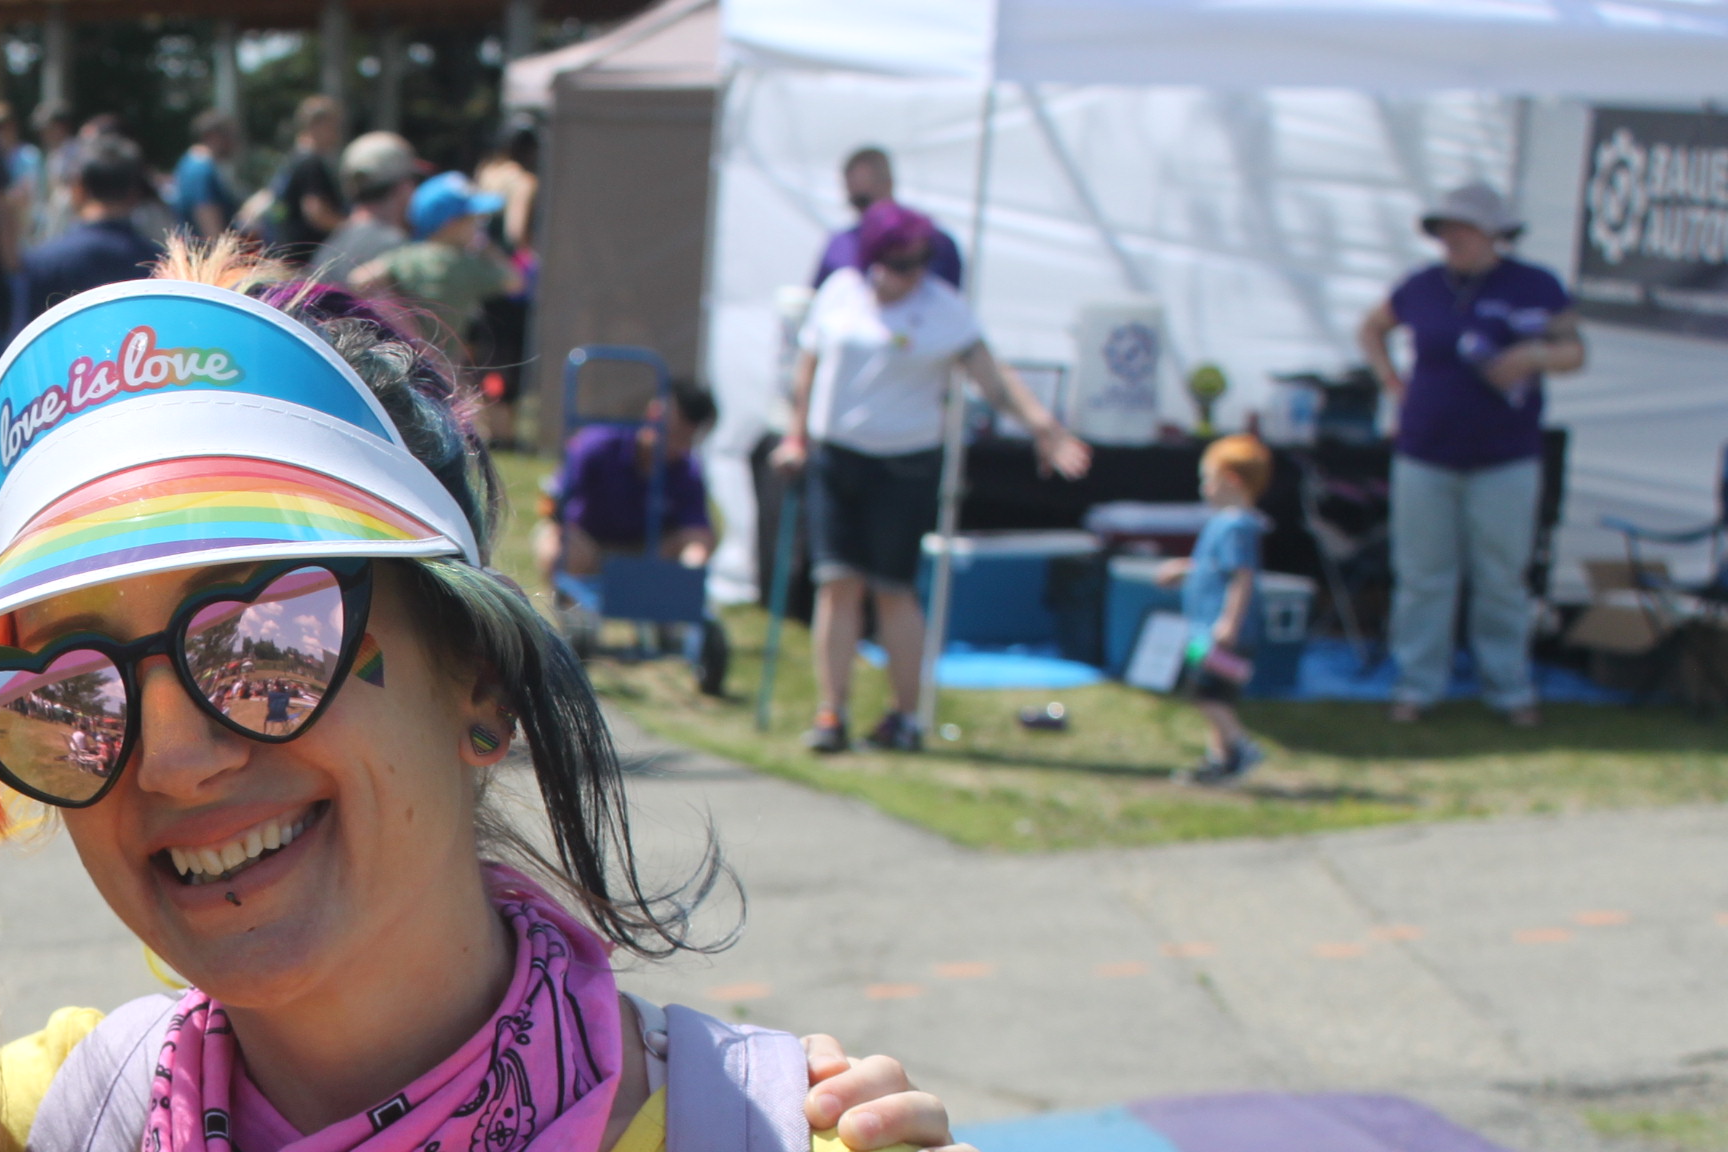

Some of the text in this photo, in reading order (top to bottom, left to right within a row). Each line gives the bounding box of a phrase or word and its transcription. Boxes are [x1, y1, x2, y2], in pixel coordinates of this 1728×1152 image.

[1640, 204, 1728, 262] AUTO
[0, 331, 239, 467] love is love
